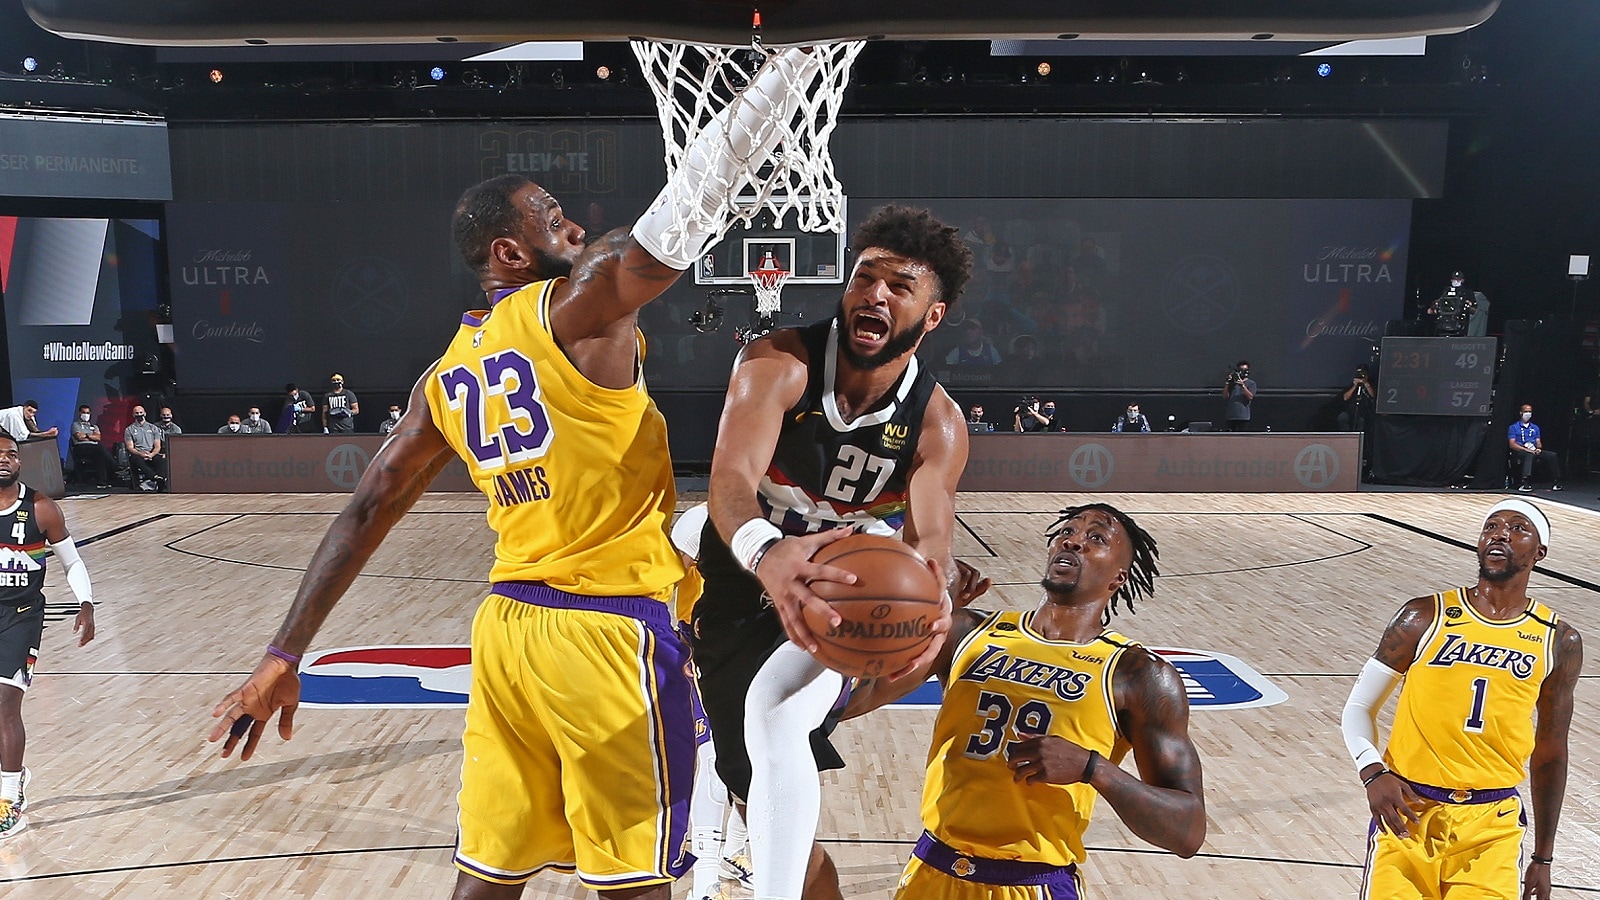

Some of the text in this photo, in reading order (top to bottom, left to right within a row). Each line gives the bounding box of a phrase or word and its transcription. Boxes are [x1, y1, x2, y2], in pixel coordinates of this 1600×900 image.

[35, 156, 138, 174] PERMANENTE
[182, 266, 270, 285] ULTRA
[1303, 263, 1392, 283] ULTRA
[192, 319, 266, 343] Courtside
[1305, 318, 1380, 342] Courtside
[43, 341, 134, 361] #WholeNewGame
[1451, 343, 1487, 351] NUGGETS
[1391, 351, 1431, 369] 2:31
[1454, 353, 1479, 370] 49
[952, 373, 992, 382] Microsoft
[328, 395, 347, 409] VOTE
[1386, 388, 1398, 404] 2
[1450, 391, 1475, 408] 57
[437, 347, 556, 470] 23
[884, 422, 909, 438] WU
[190, 456, 320, 479] Autotrader
[824, 444, 898, 504] 27
[1155, 456, 1289, 479] Autotrader
[492, 465, 551, 508] JAMES
[11, 522, 26, 545] 4
[1517, 630, 1543, 644] wish
[1072, 650, 1104, 665] wish
[1427, 633, 1540, 680] LAKERS
[957, 644, 1093, 701] LAKERS
[1463, 677, 1489, 733] 1
[963, 690, 1053, 762] 39
